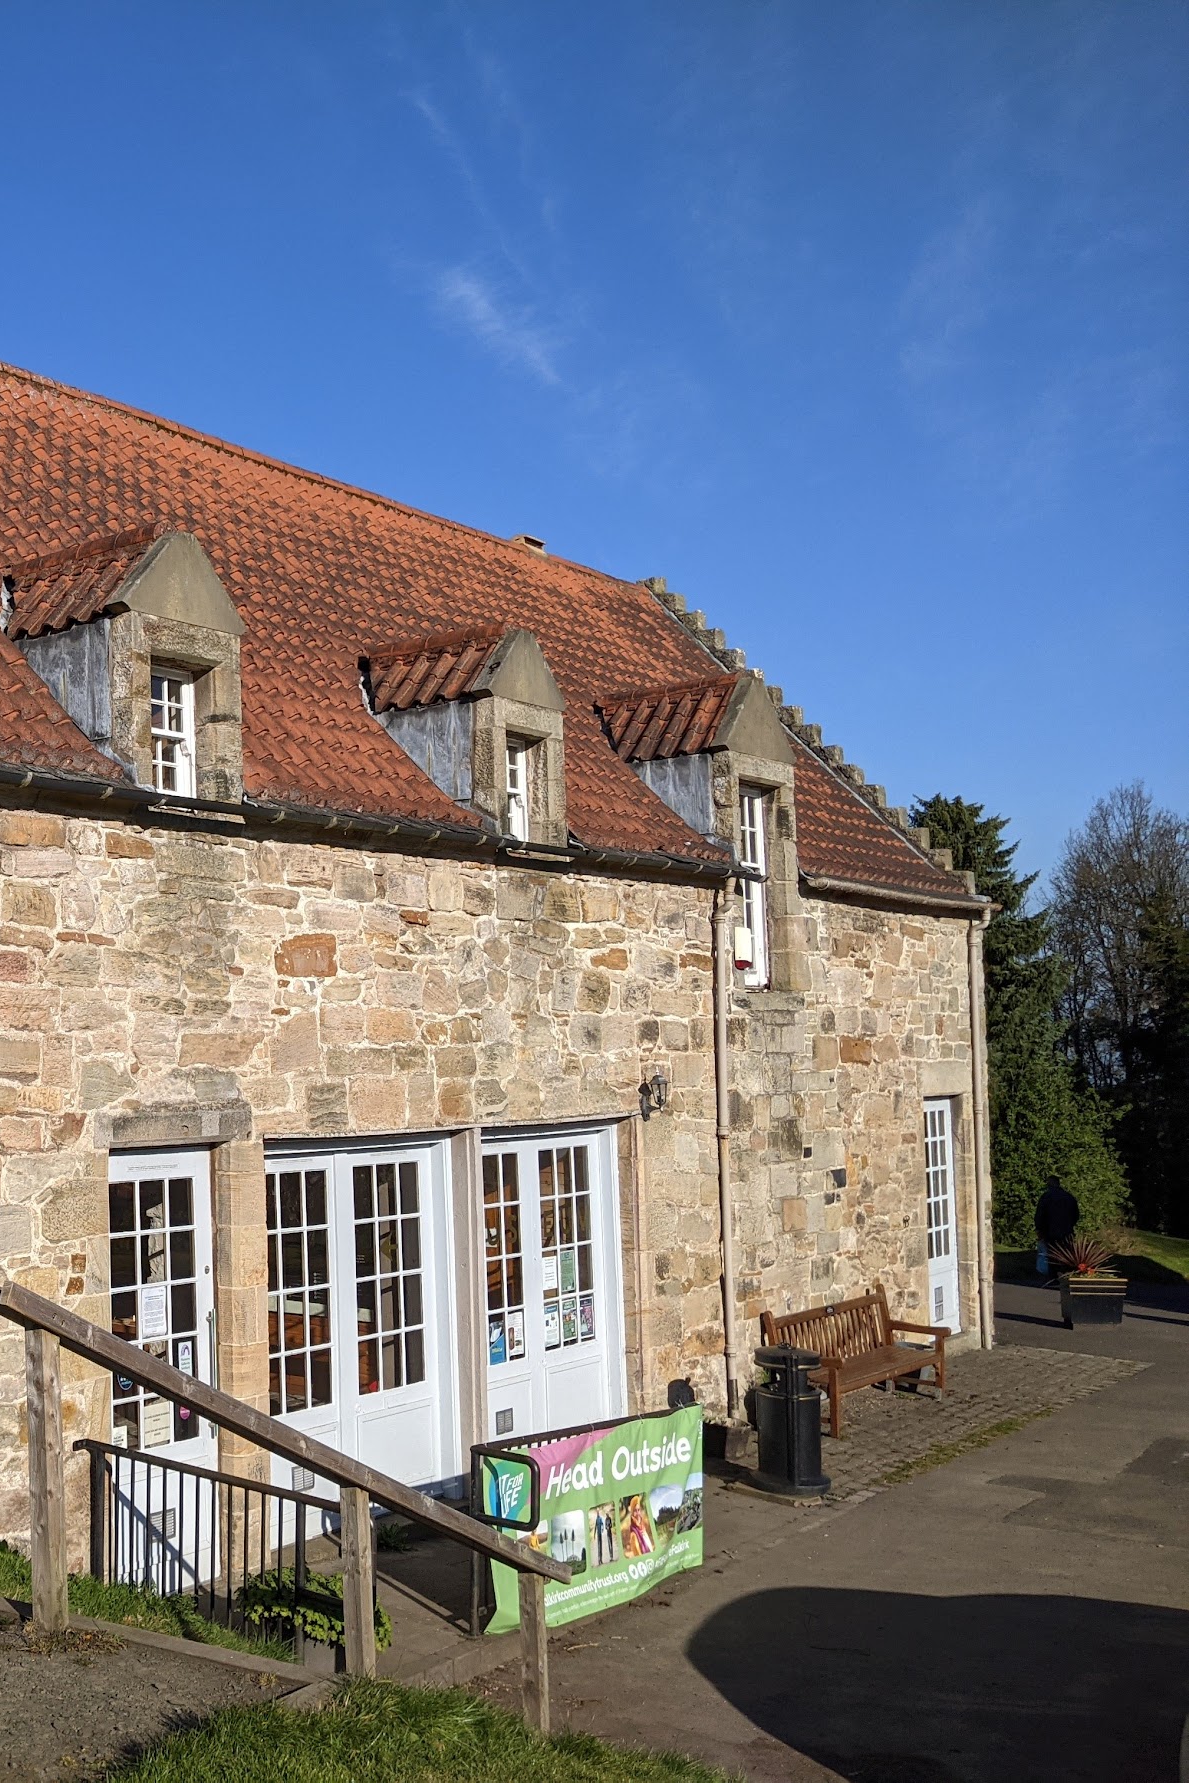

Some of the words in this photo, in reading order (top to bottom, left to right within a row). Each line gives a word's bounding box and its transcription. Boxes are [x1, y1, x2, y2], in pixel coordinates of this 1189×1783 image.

[545, 1451, 604, 1501] Head
[611, 1432, 692, 1481] Outside
[544, 1570, 629, 1607] alkirkcommunitytrust.org
